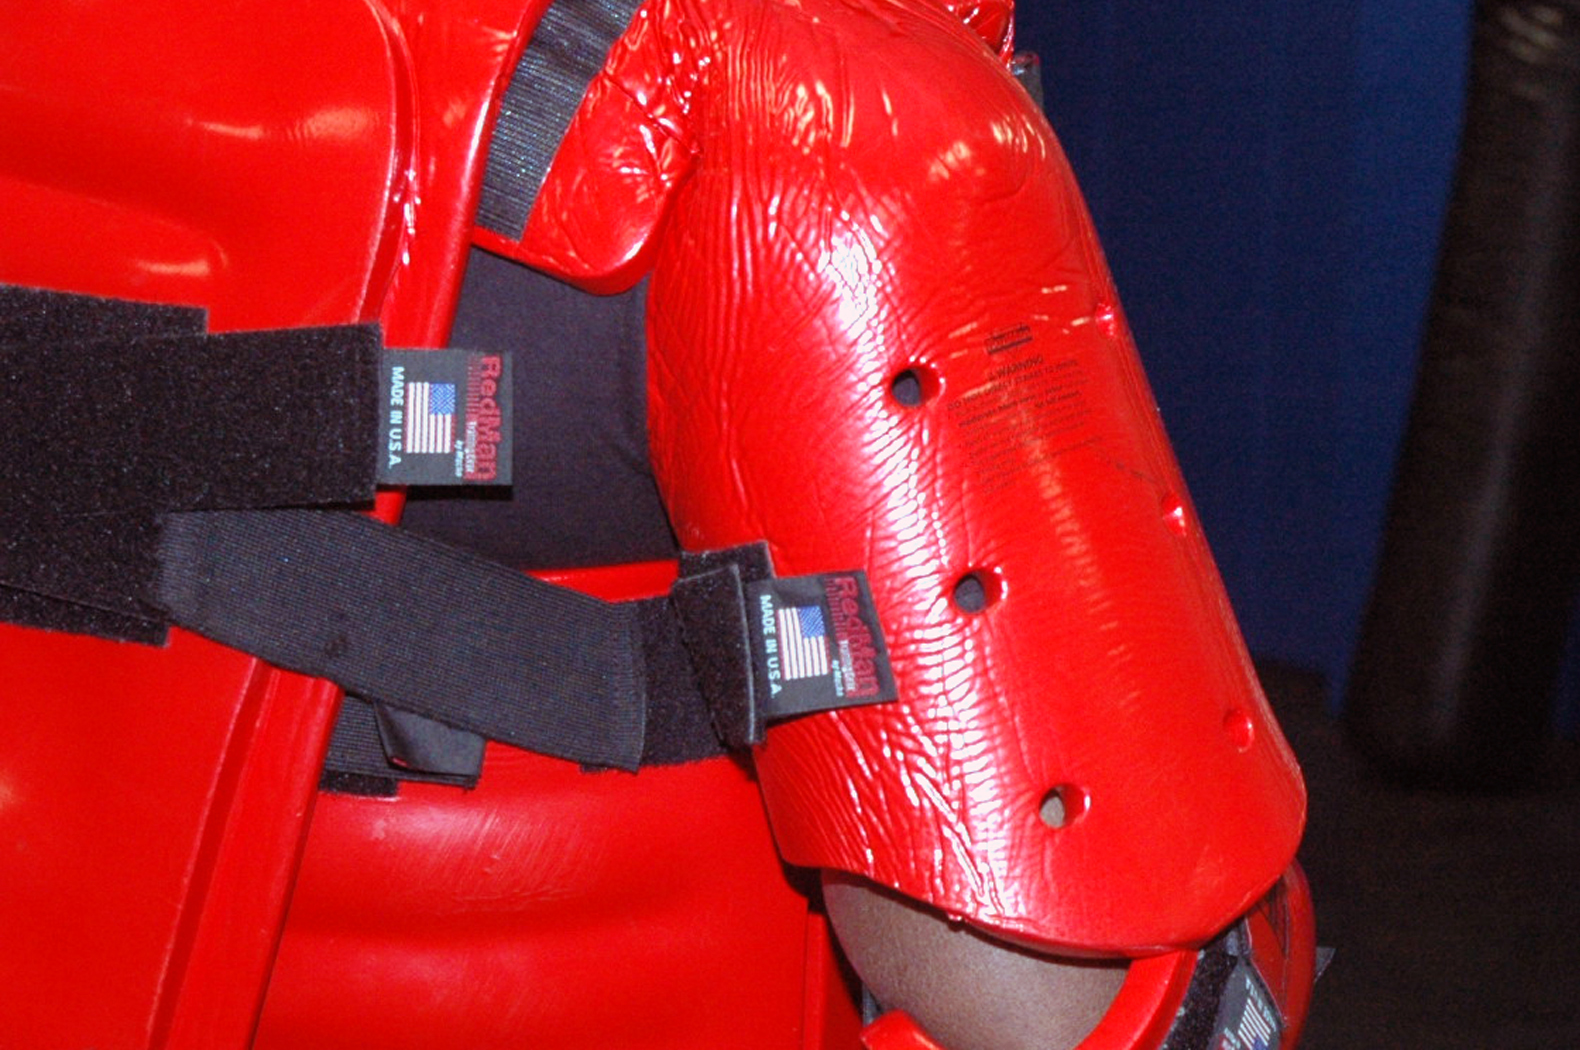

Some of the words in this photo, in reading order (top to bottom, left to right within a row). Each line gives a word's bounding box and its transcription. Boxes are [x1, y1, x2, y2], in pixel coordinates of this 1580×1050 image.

[390, 366, 405, 406] MADE
[389, 410, 402, 424] IN
[467, 355, 502, 481] RedMan
[387, 428, 402, 469] U.S.A.
[760, 594, 776, 635] MADE
[765, 638, 778, 654] IN
[834, 576, 879, 699] RedMan
